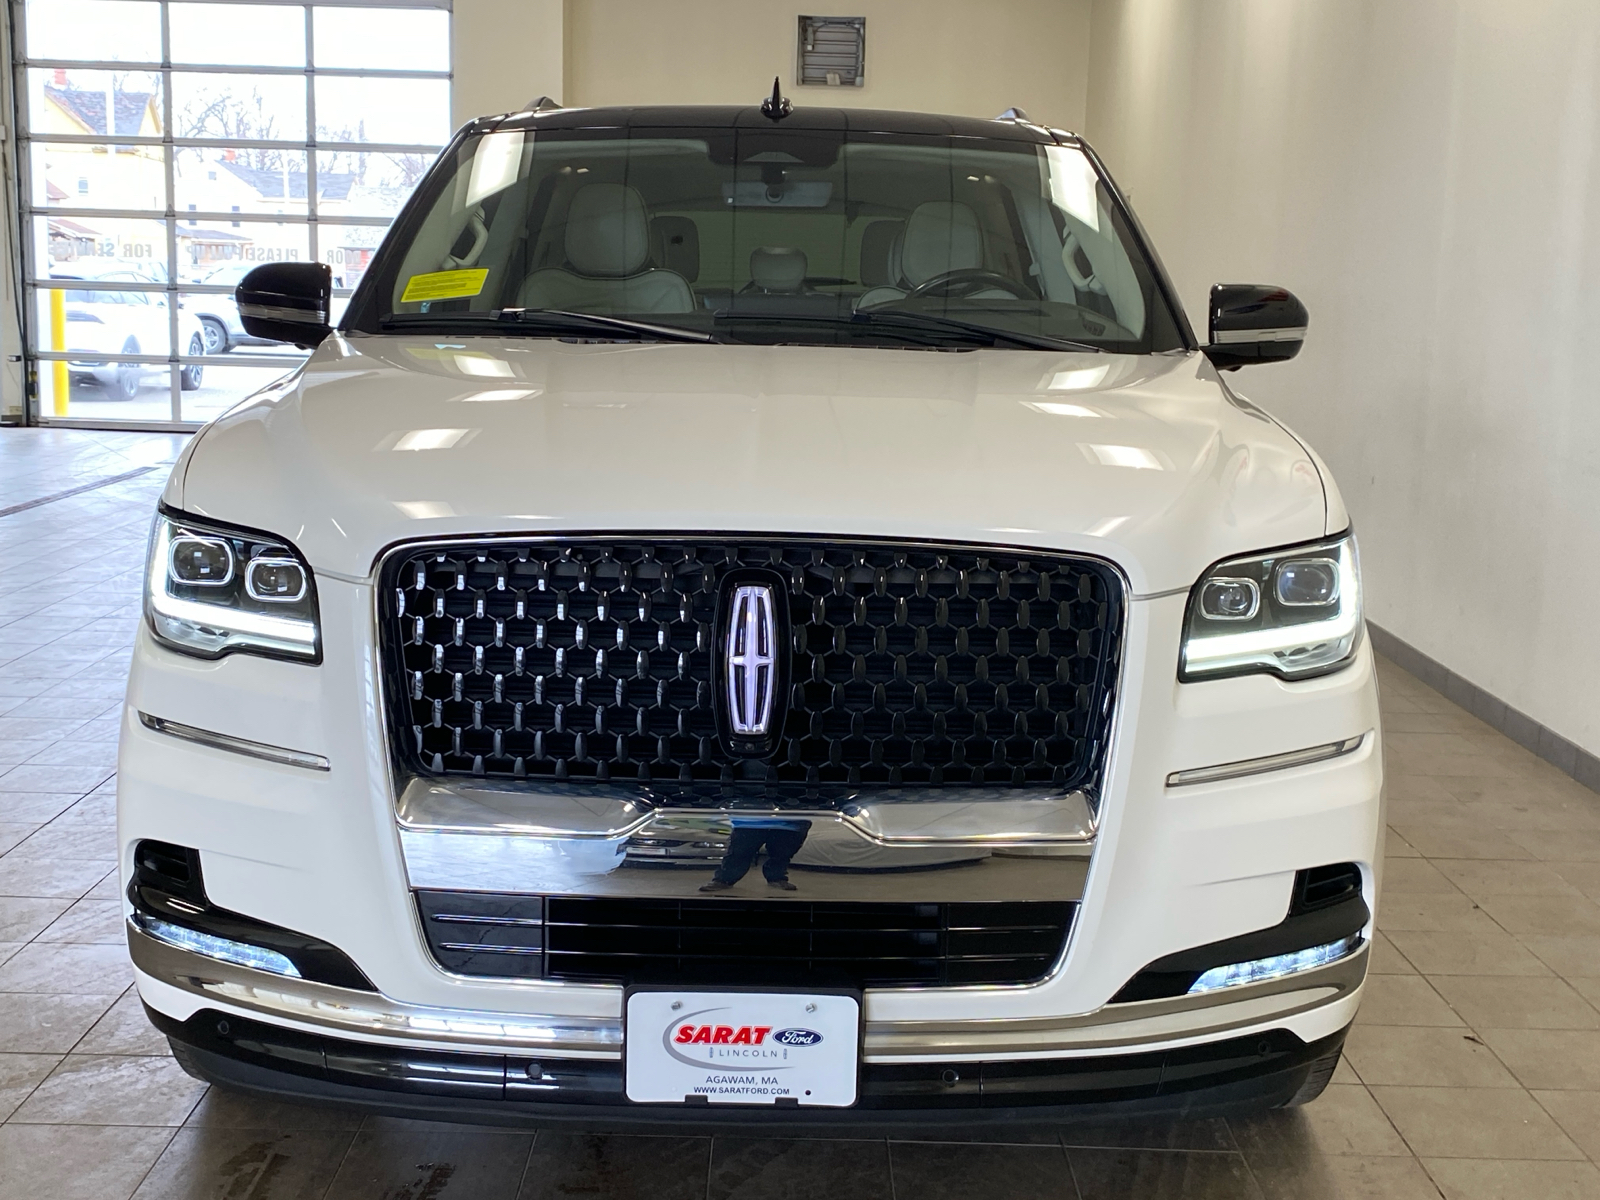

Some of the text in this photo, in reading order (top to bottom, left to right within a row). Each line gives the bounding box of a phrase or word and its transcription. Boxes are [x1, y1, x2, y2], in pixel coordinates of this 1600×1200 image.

[673, 1023, 814, 1046] SARAT Ford
[719, 1049, 778, 1058] LINCOLN
[705, 1075, 778, 1086] AGAWAM, MA
[694, 1086, 790, 1096] WWW.SARATFORD.COM
